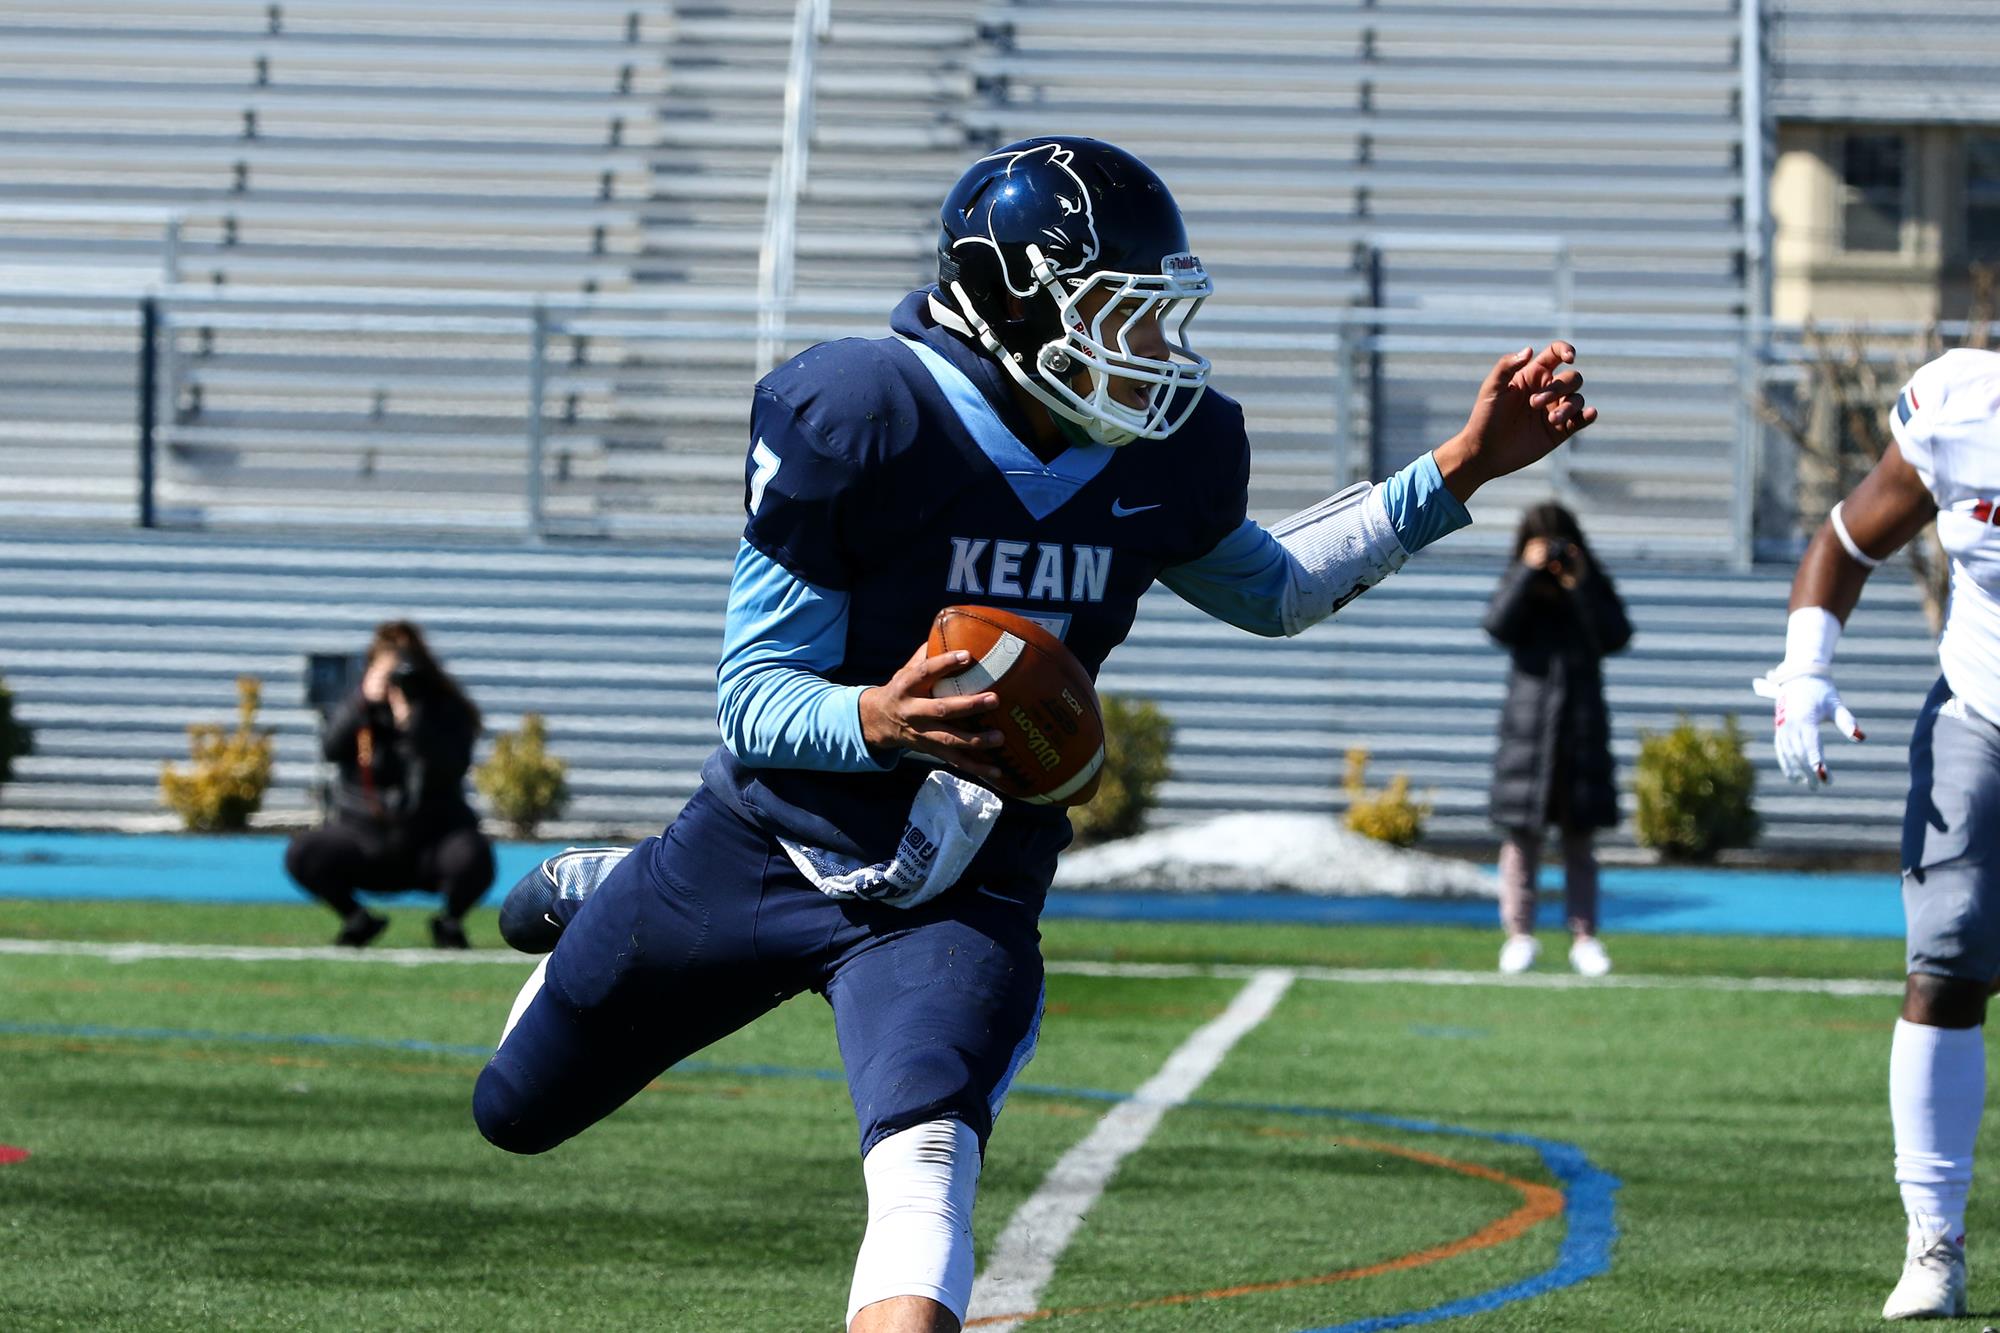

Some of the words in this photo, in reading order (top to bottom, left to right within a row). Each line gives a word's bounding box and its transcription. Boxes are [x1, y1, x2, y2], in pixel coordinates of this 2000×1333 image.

[750, 437, 782, 516] 7
[946, 537, 1113, 602] KEAN
[1009, 704, 1061, 771] Wilson
